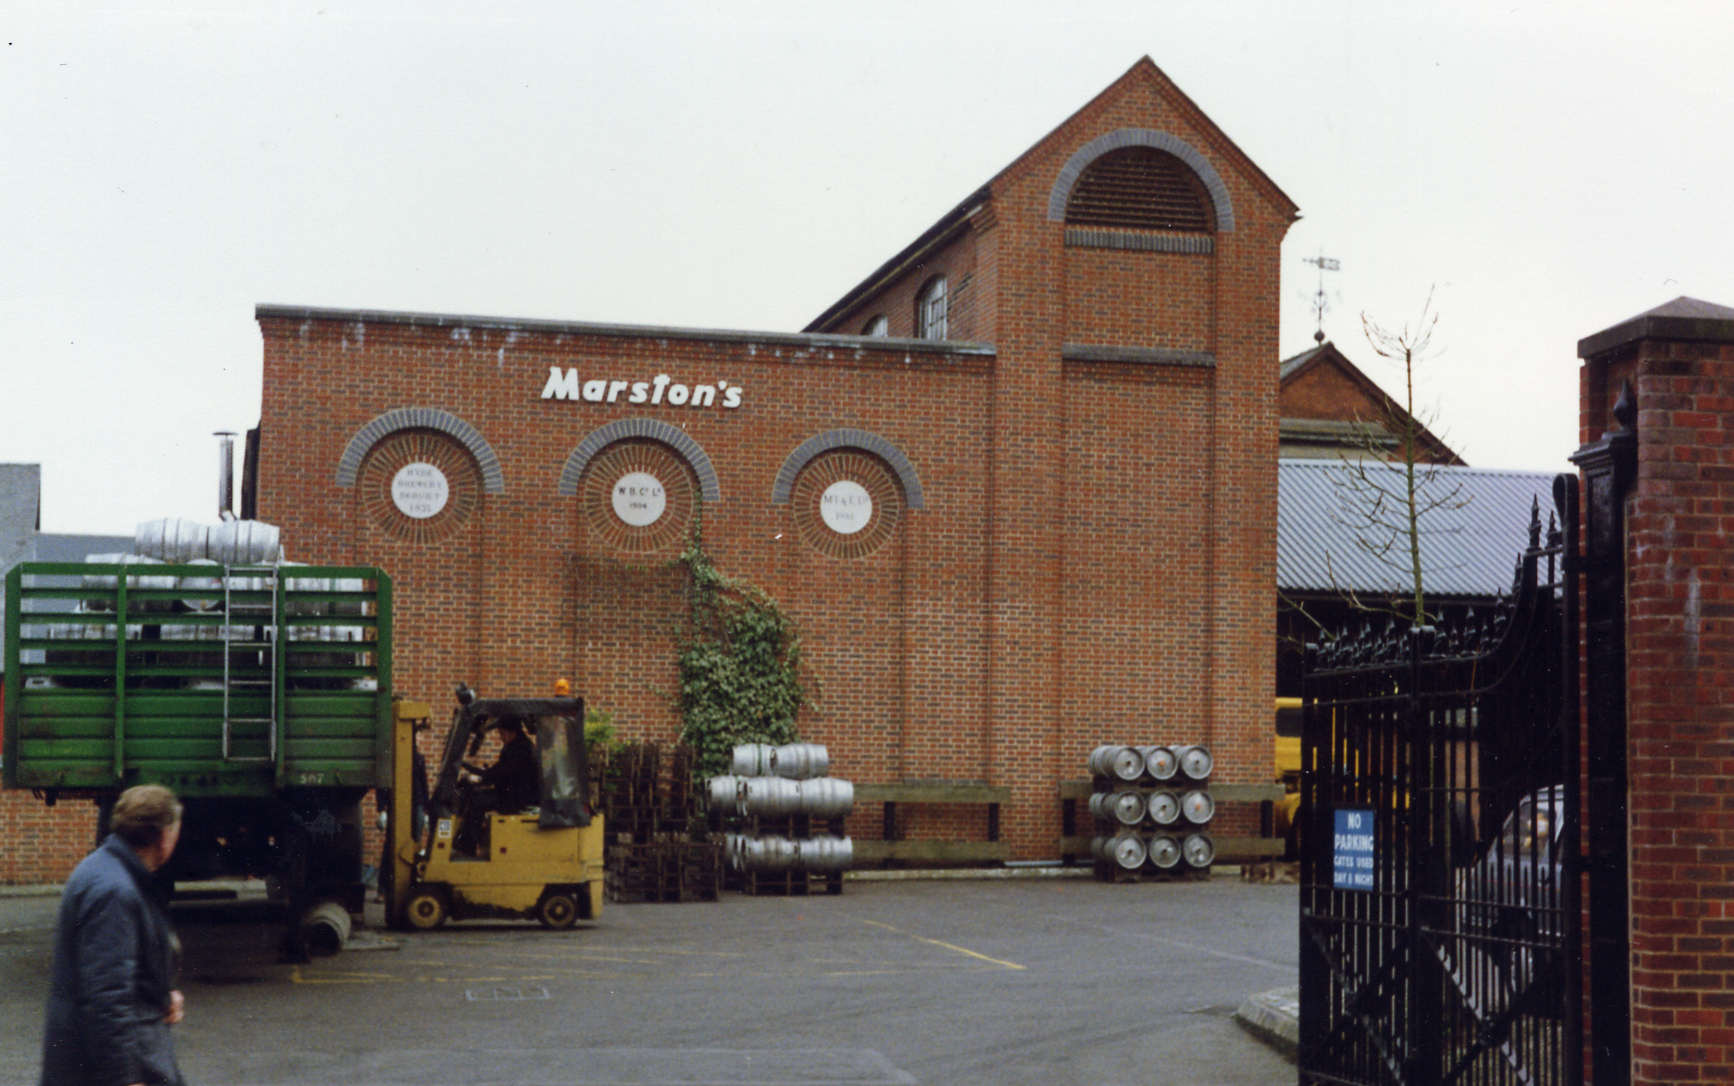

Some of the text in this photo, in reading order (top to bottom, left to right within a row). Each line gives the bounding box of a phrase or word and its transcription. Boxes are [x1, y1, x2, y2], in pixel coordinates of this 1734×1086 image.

[541, 366, 743, 408] Marston's
[1347, 812, 1361, 829] NO
[1334, 834, 1374, 851] PARKING
[1355, 874, 1374, 886] NIGHT
